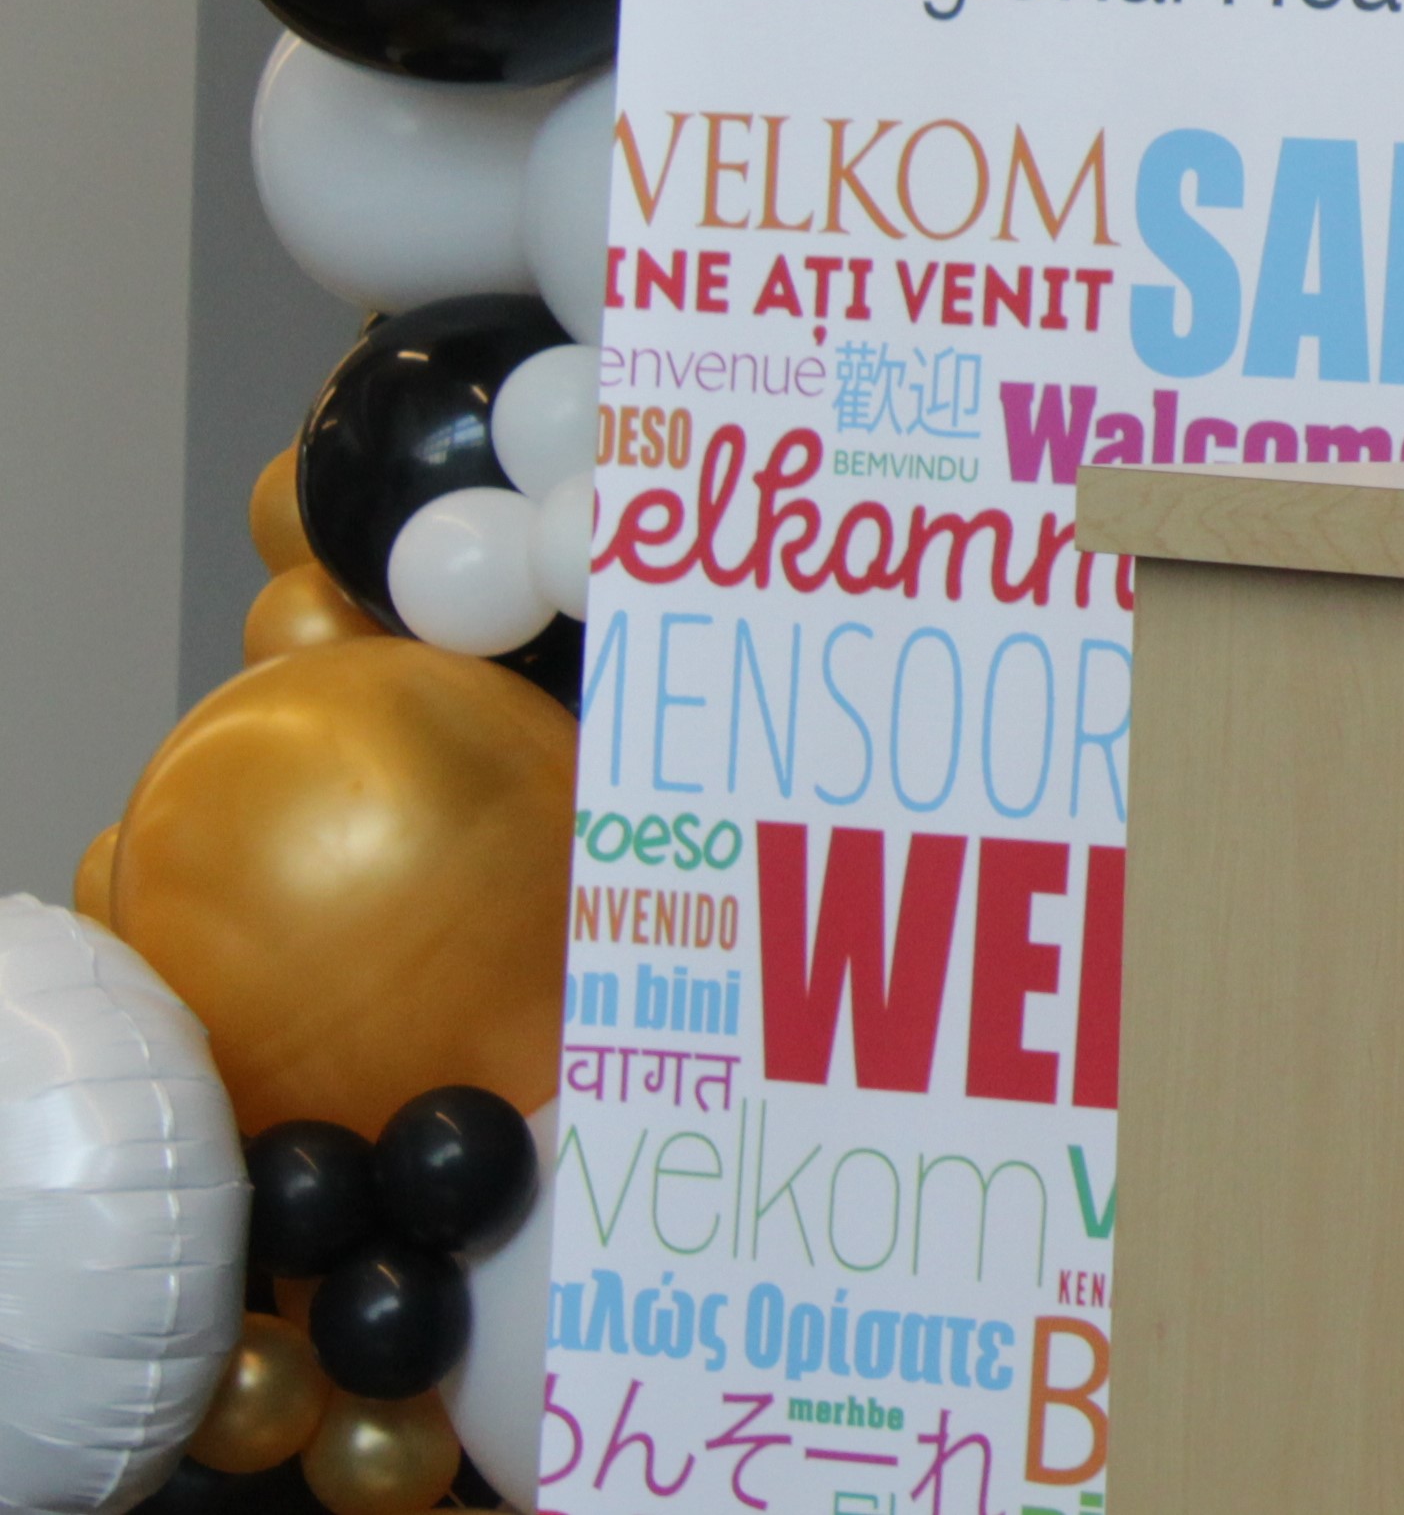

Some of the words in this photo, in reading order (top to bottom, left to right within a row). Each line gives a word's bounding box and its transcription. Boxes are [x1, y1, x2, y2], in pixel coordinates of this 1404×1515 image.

[894, 258, 1115, 333] VENIT
[832, 341, 982, 439] 歡迎
[833, 449, 979, 483] BEMVINDU
[574, 885, 739, 951] NVENIDO
[634, 963, 741, 1036] bini
